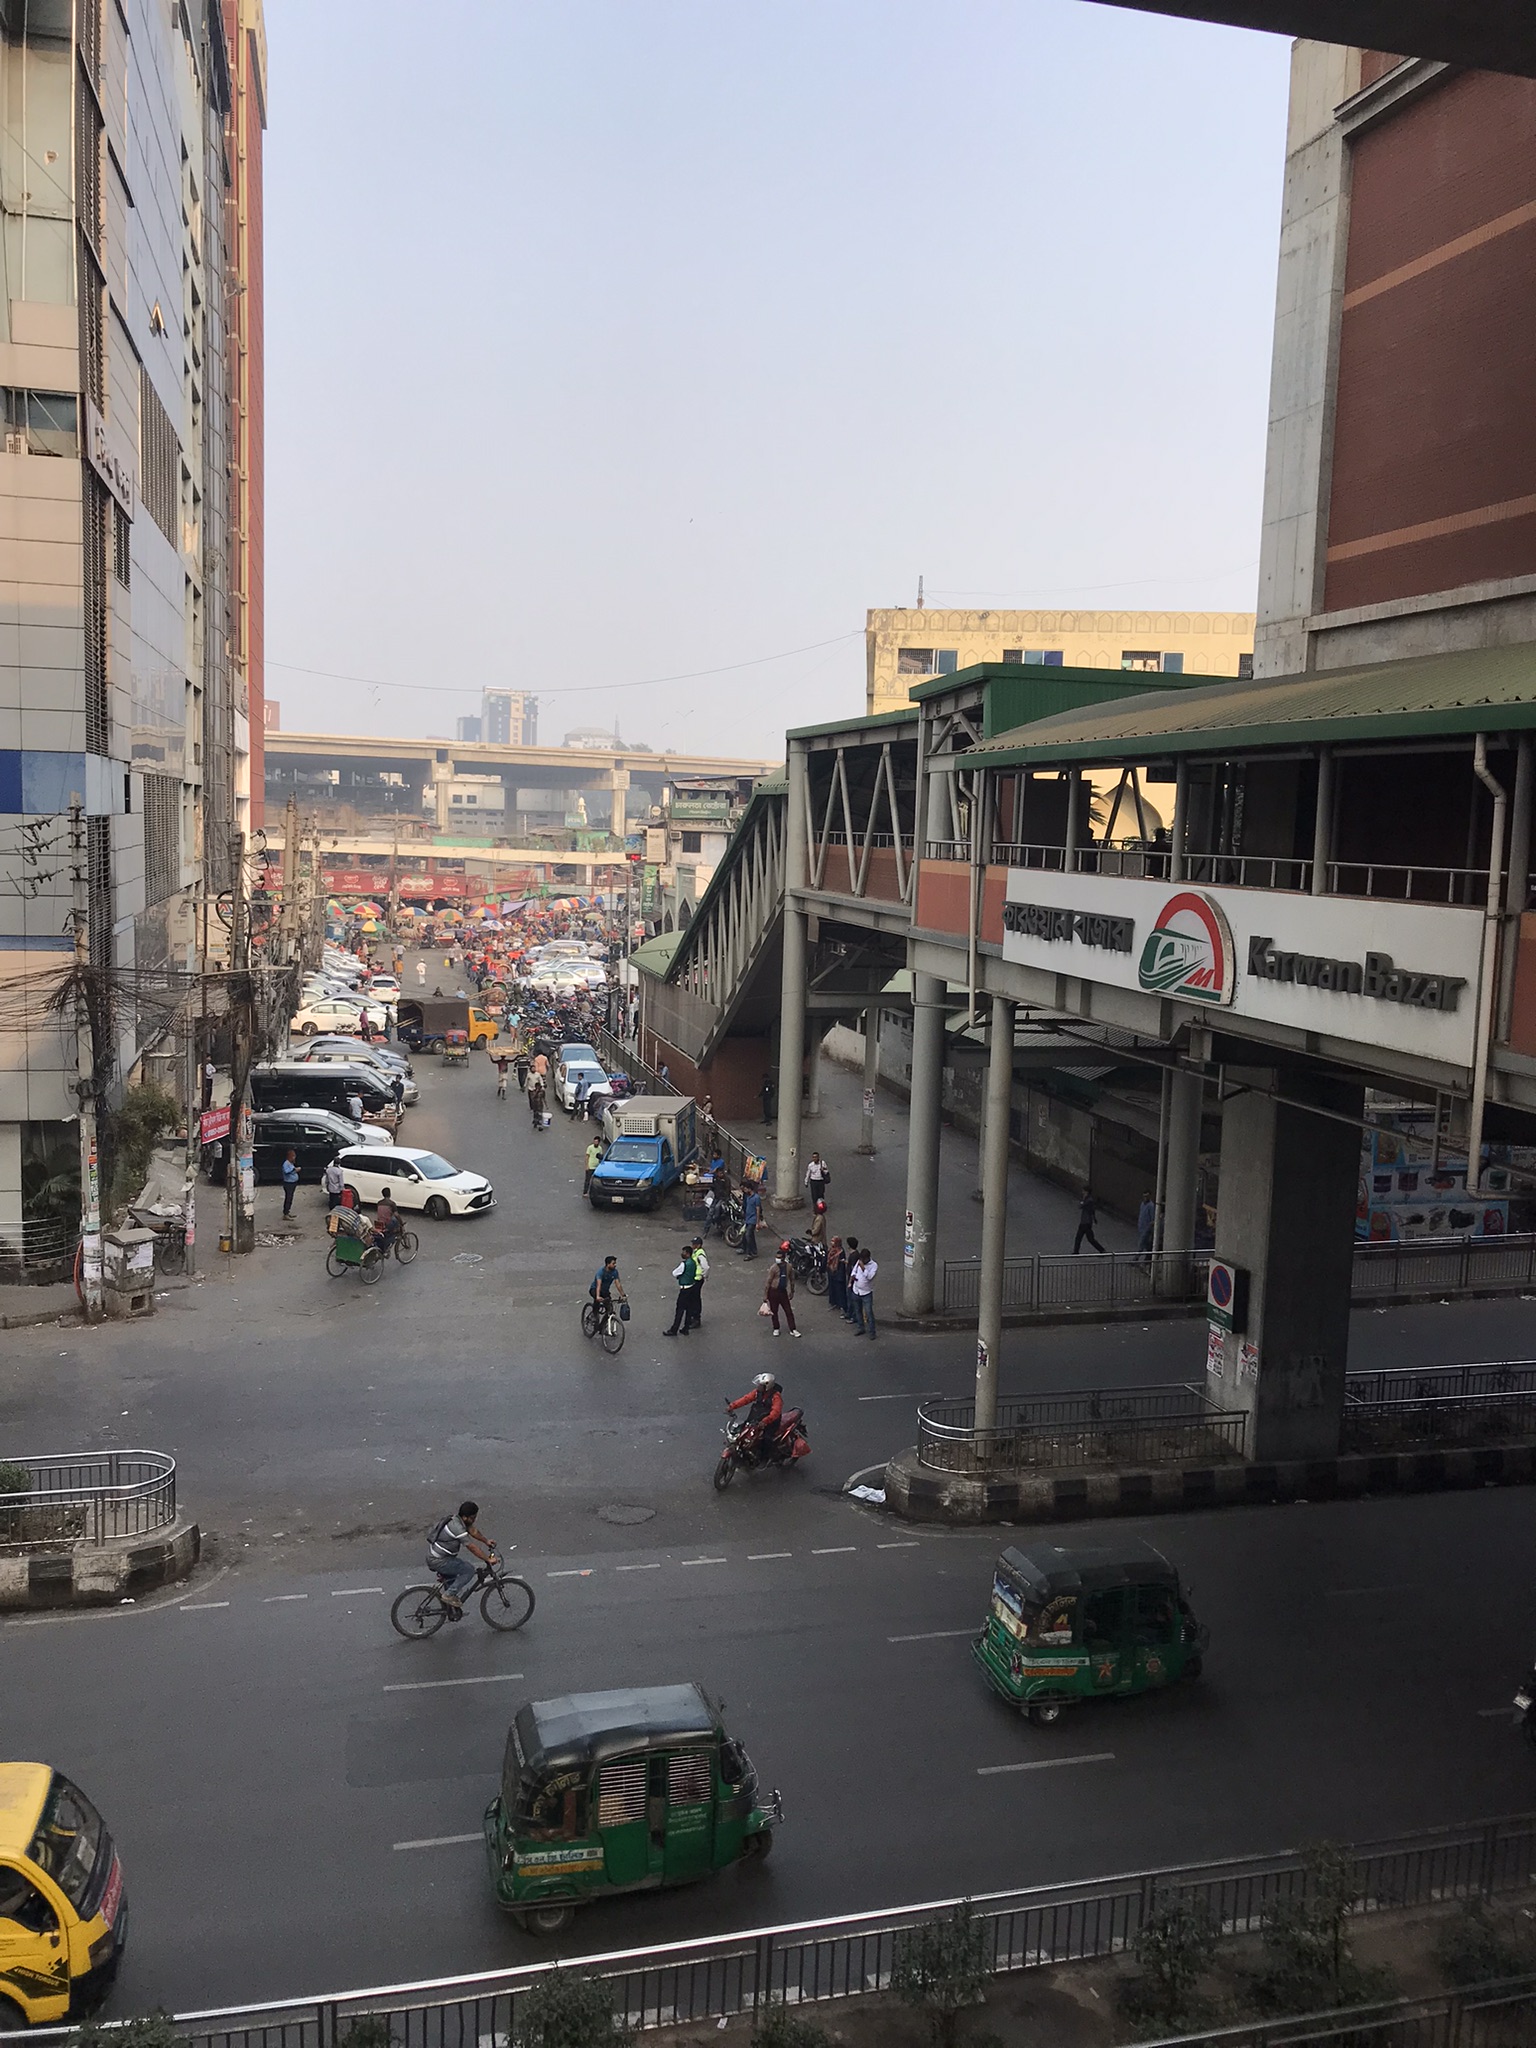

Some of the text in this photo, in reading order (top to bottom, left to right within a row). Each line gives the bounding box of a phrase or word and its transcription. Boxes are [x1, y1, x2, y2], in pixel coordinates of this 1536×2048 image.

[1073, 910, 1134, 952] বাজার
[1248, 936, 1467, 1011] Karwan Bazar
